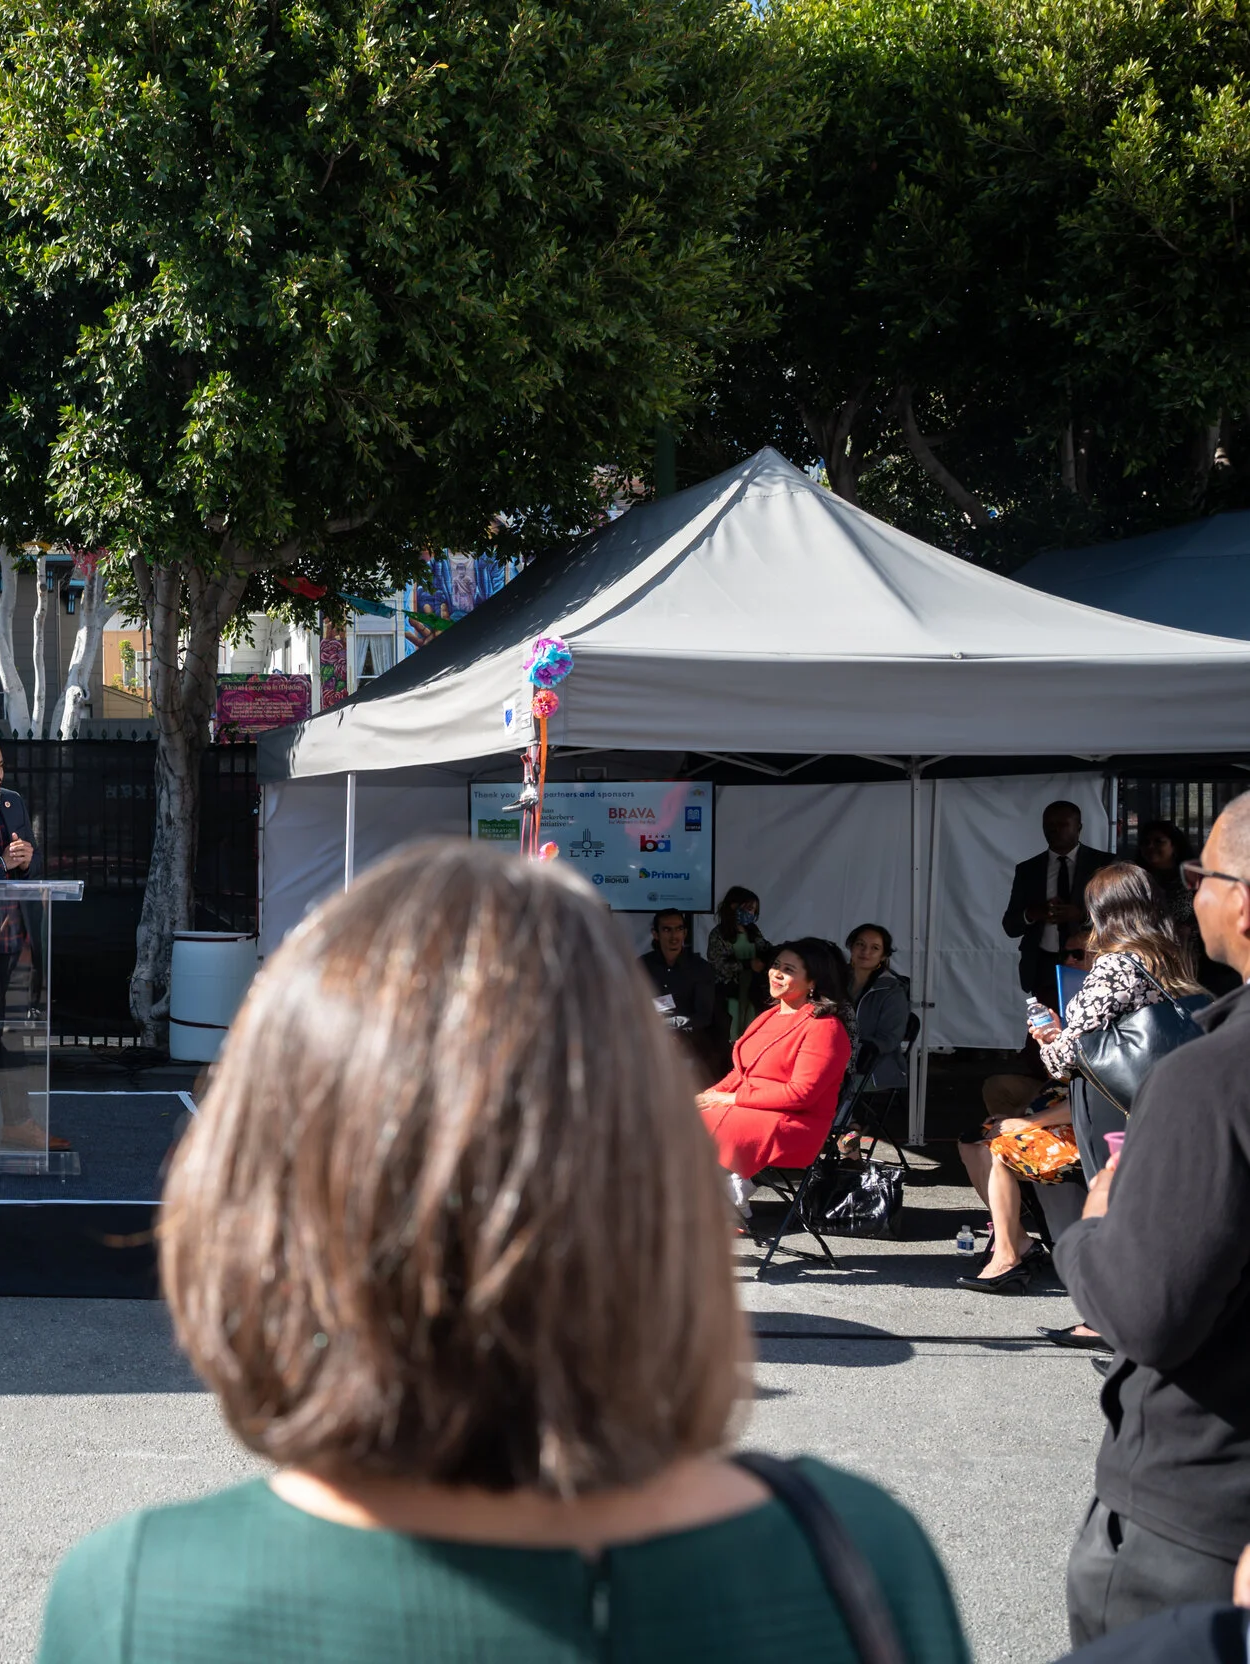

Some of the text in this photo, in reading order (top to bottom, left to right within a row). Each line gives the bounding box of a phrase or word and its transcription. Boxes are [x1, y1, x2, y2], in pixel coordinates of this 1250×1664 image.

[544, 792, 577, 800] partners
[598, 791, 634, 799] sponsors
[609, 807, 655, 818] BRAVA
[540, 814, 575, 822] uckerberg
[651, 870, 690, 880] Primary
